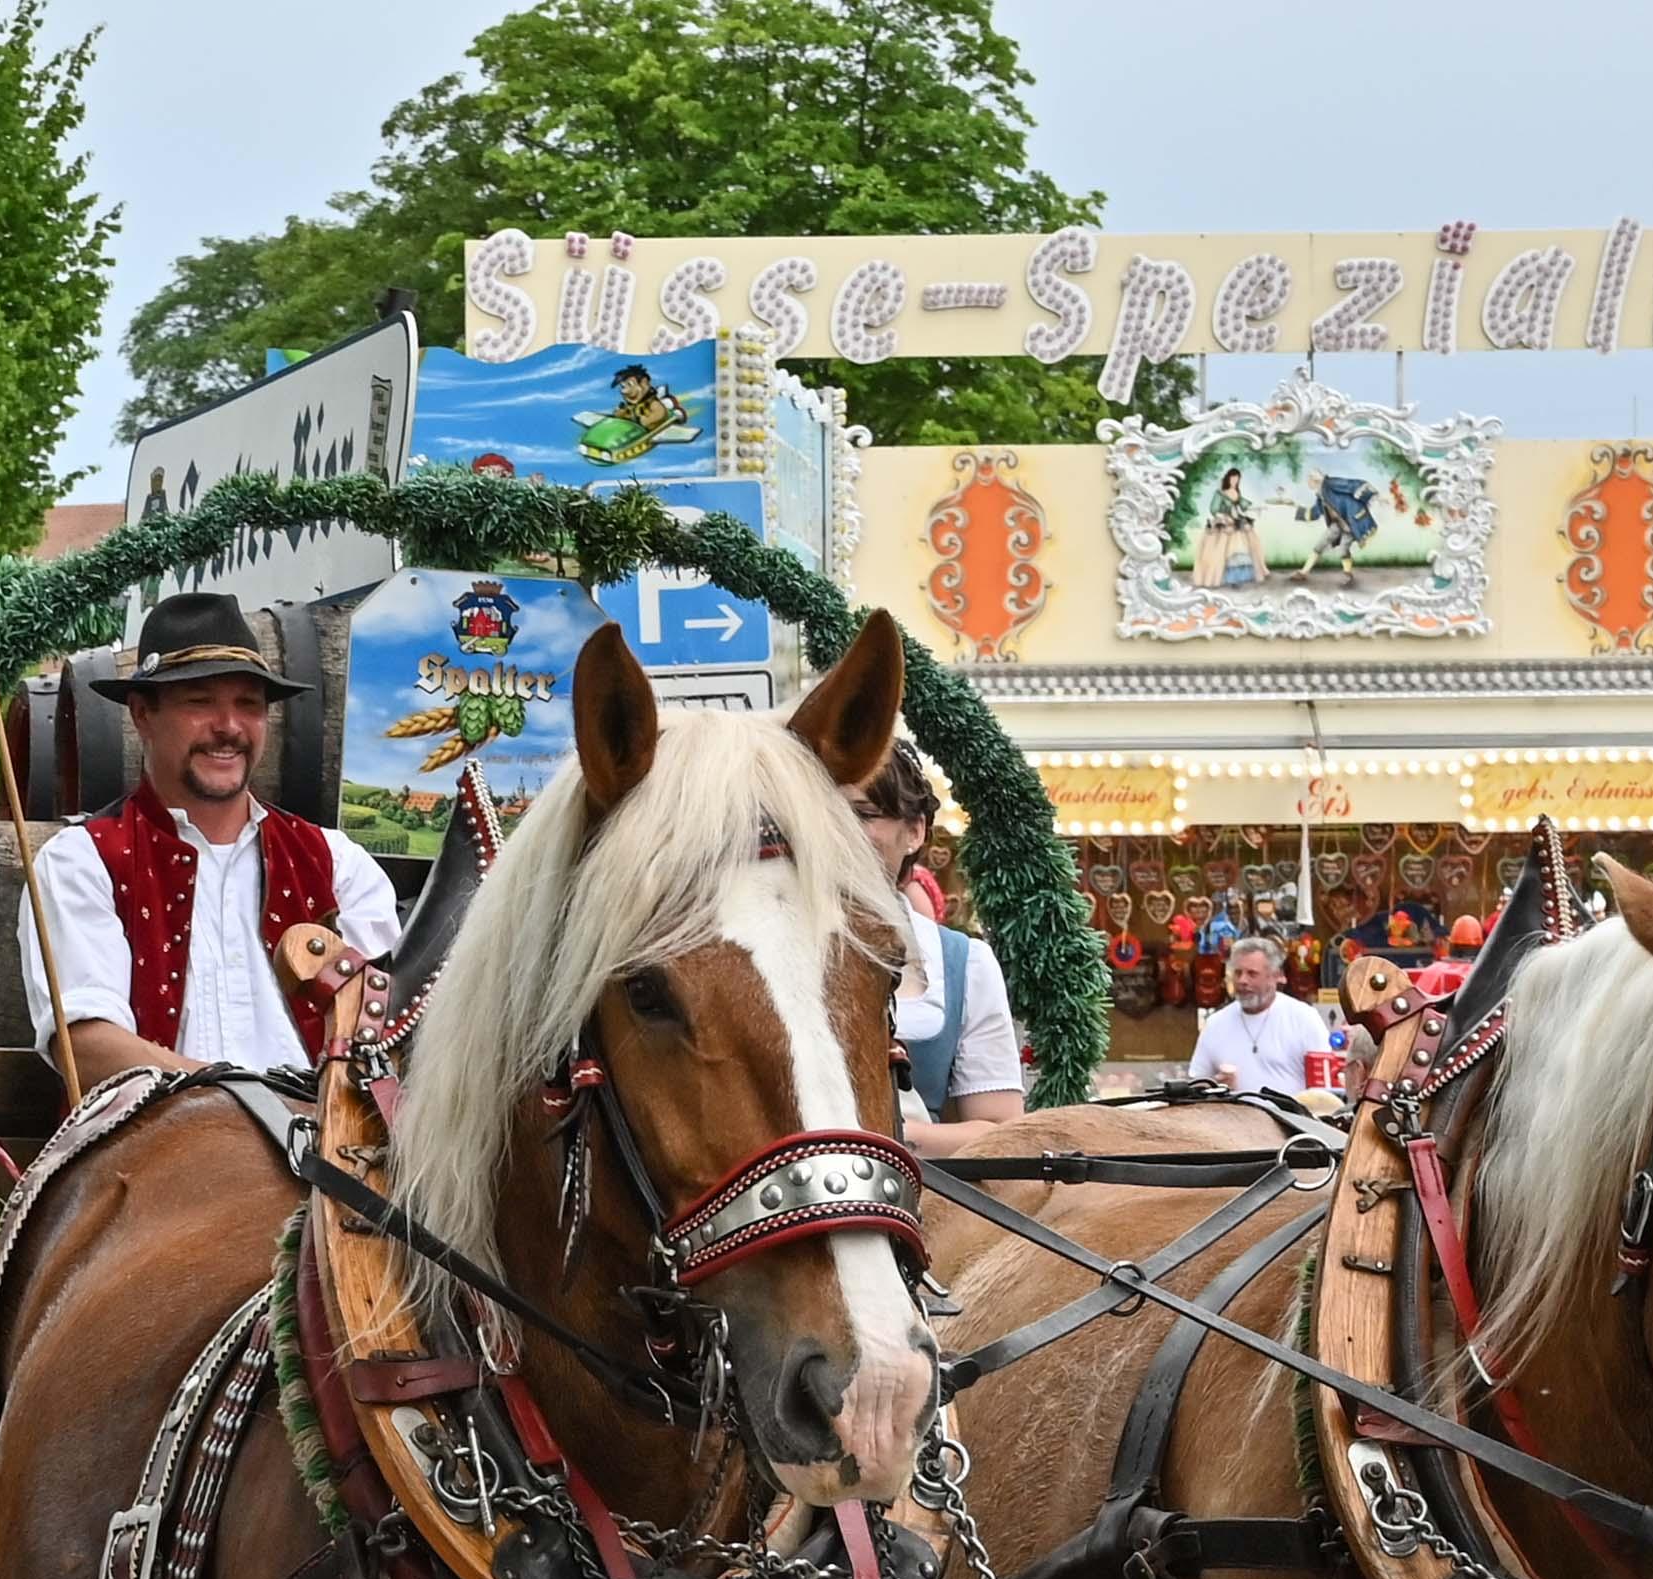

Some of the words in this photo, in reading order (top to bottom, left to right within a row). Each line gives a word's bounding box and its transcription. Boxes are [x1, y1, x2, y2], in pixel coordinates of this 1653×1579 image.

[413, 651, 557, 703] Spalter
[1296, 777, 1351, 818] Eis
[1499, 775, 1555, 810] gebr.
